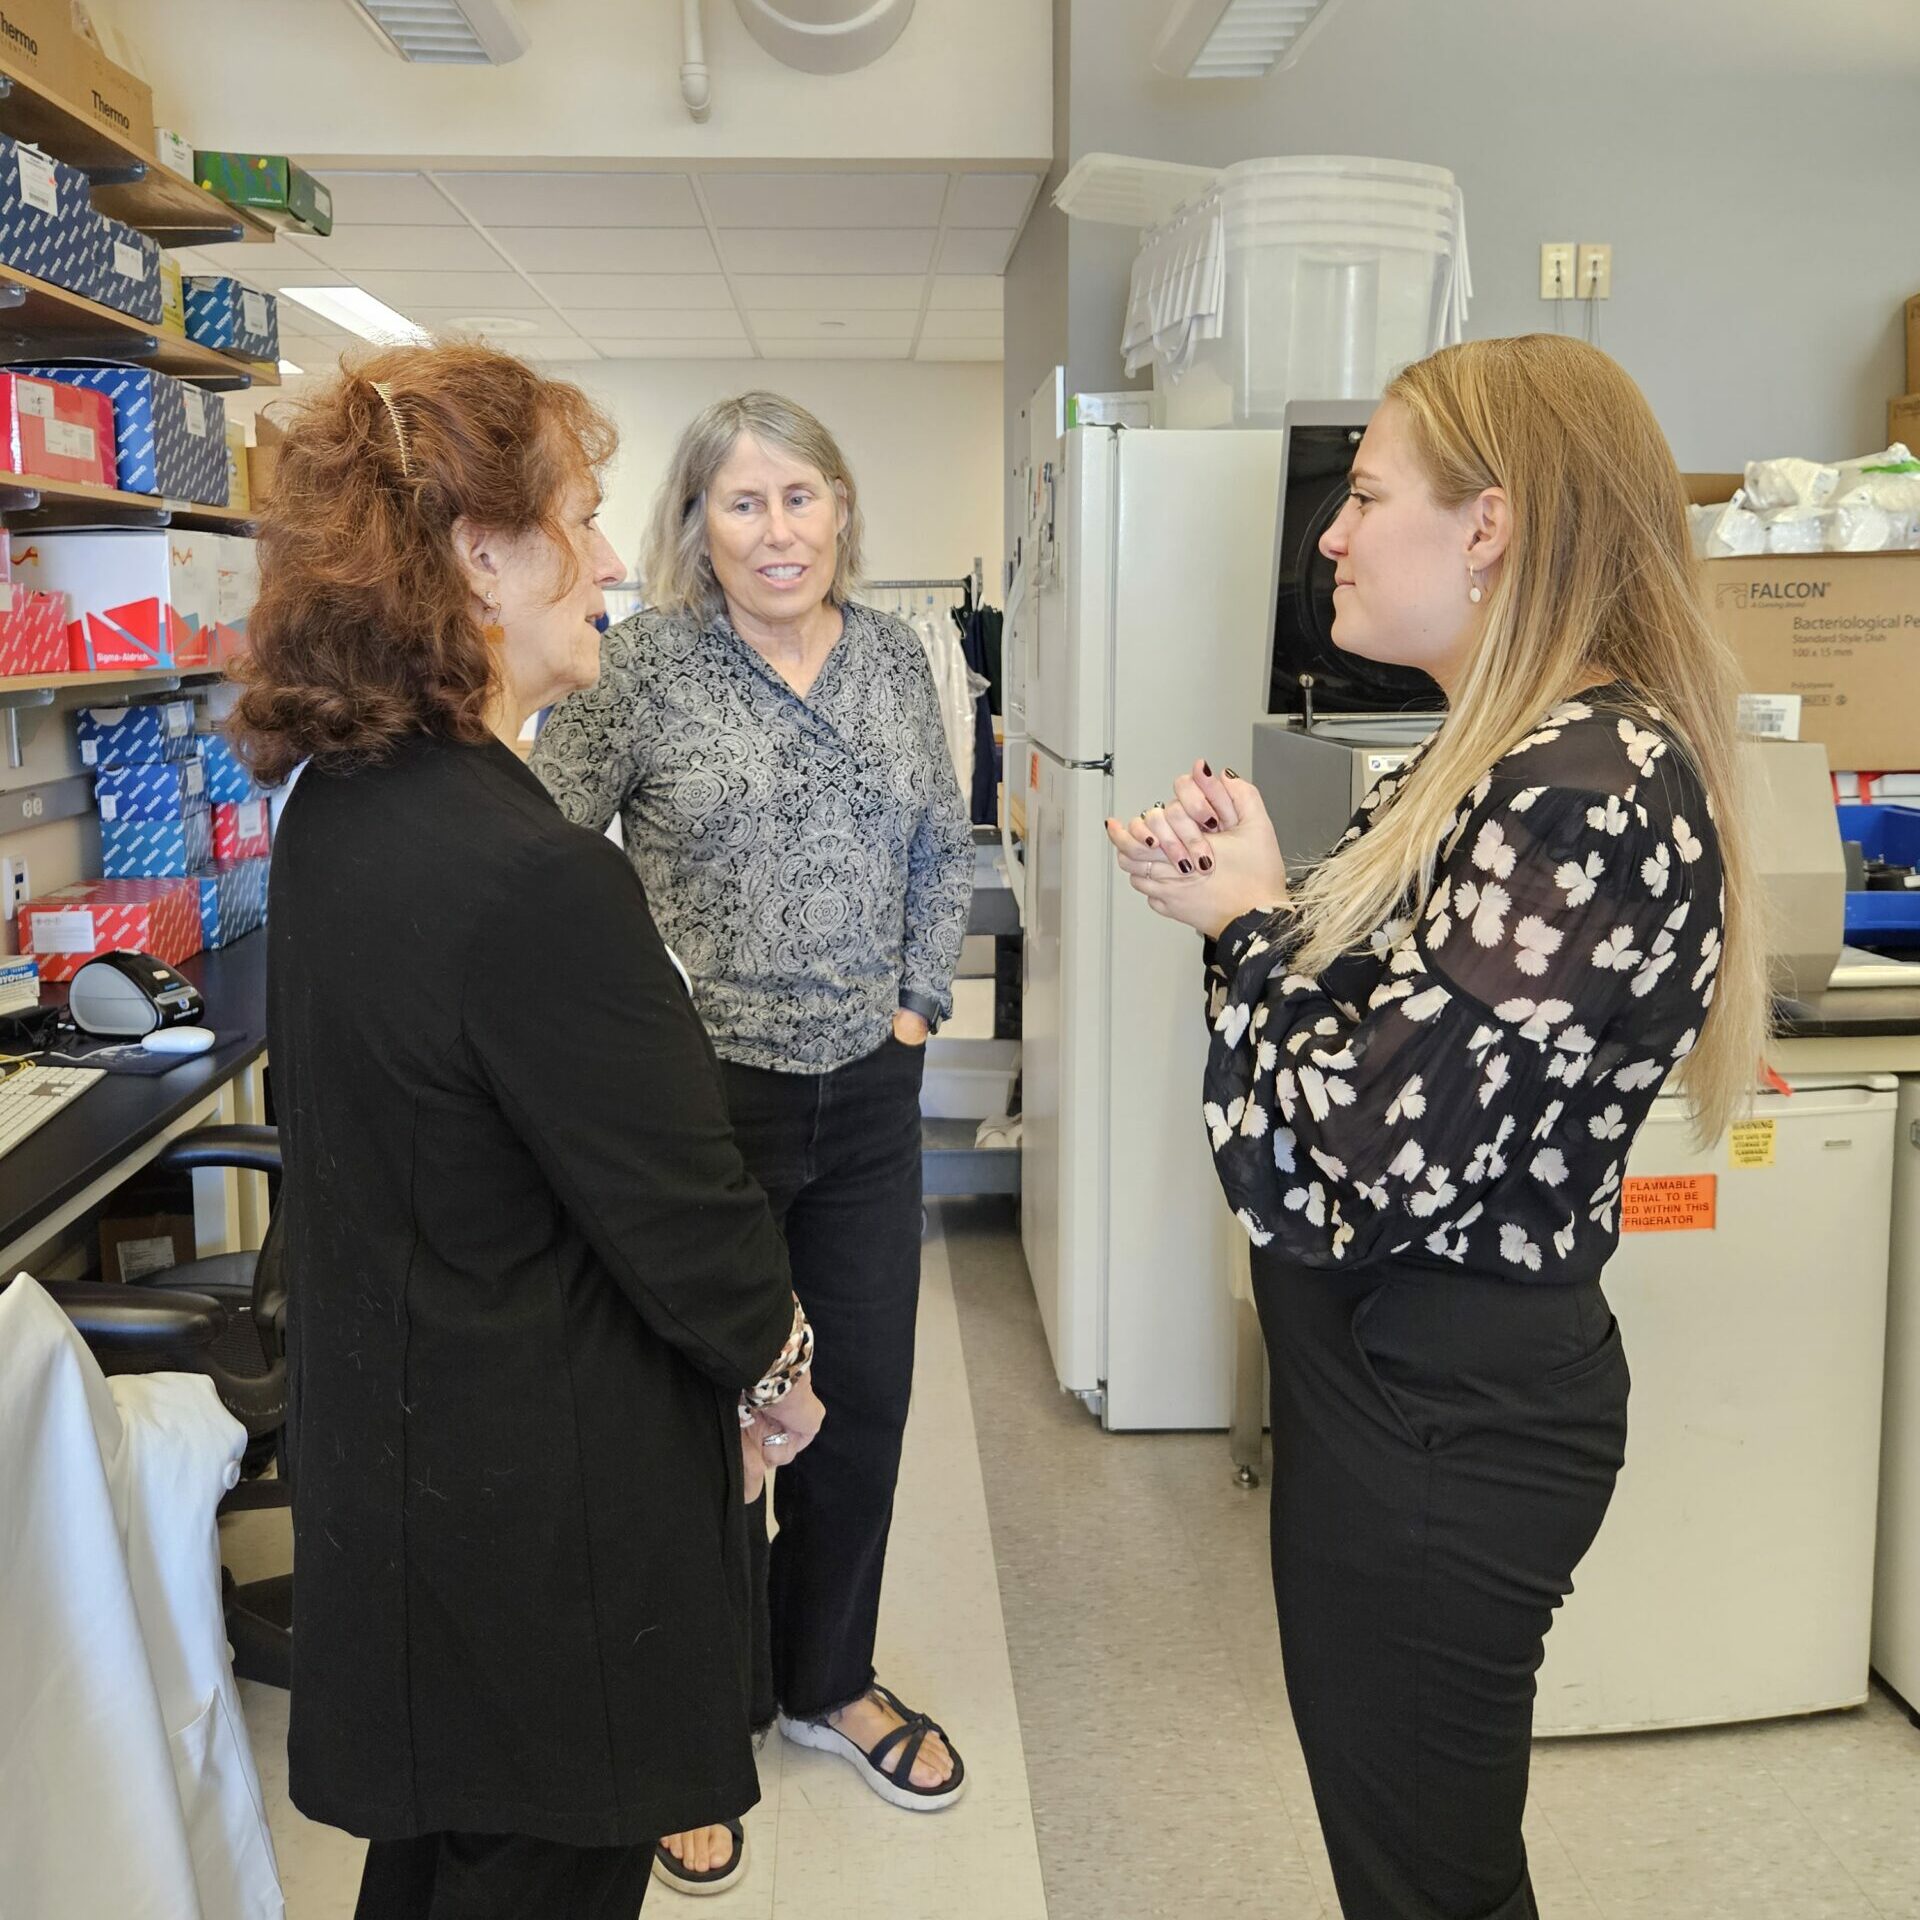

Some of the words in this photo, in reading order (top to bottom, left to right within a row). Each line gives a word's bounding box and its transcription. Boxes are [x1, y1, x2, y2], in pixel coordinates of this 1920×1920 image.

[92, 90, 129, 129] Thermo
[117, 423, 138, 443] QIAGEN
[1793, 615, 1901, 631] Bacteriological
[1792, 634, 1836, 643] Standard
[1838, 634, 1862, 645] Style
[1865, 634, 1887, 643] Dish
[1792, 648, 1810, 657] 100
[1820, 648, 1831, 656] 15
[1833, 649, 1854, 657] mm
[1732, 1120, 1773, 1130] WARNING
[1630, 1180, 1697, 1191] FLAMMABLE
[1666, 1192, 1680, 1201] TO
[1684, 1191, 1698, 1200] BE
[1623, 1206, 1639, 1214] ED
[1644, 1204, 1681, 1214] WITHIN
[1686, 1202, 1709, 1212] THIS
